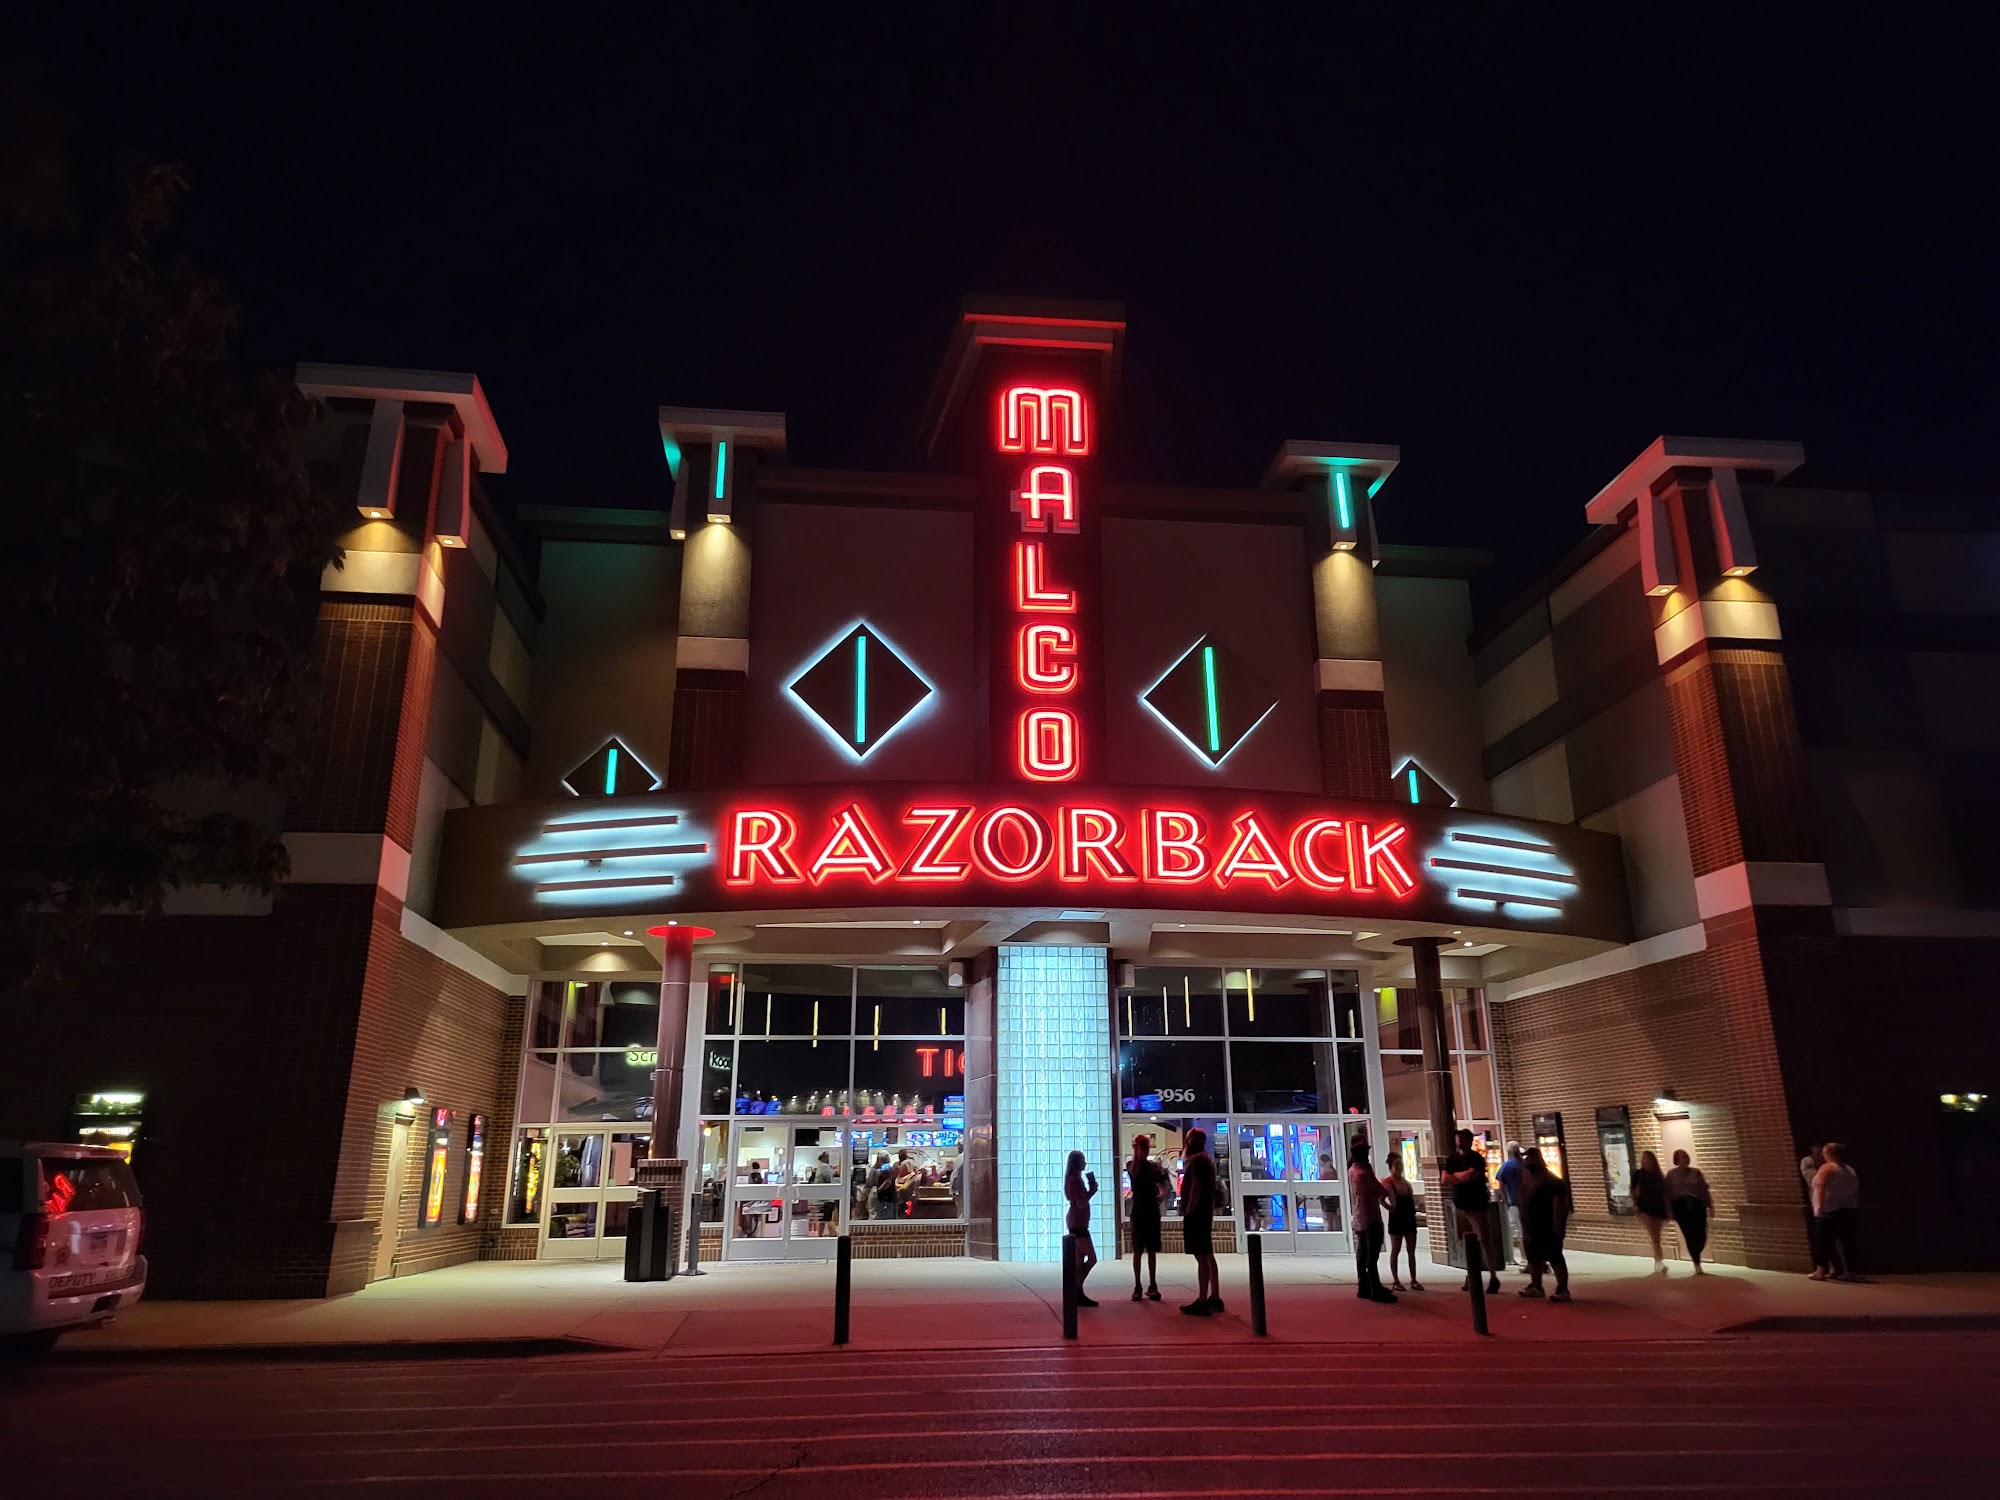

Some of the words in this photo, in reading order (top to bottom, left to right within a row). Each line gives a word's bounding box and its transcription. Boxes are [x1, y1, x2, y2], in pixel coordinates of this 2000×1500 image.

[999, 386, 1090, 782] MALCO
[726, 802, 1419, 898] RAZORBACK
[1154, 1088, 1196, 1103] 3956
[48, 1272, 97, 1289] DEPUTY
